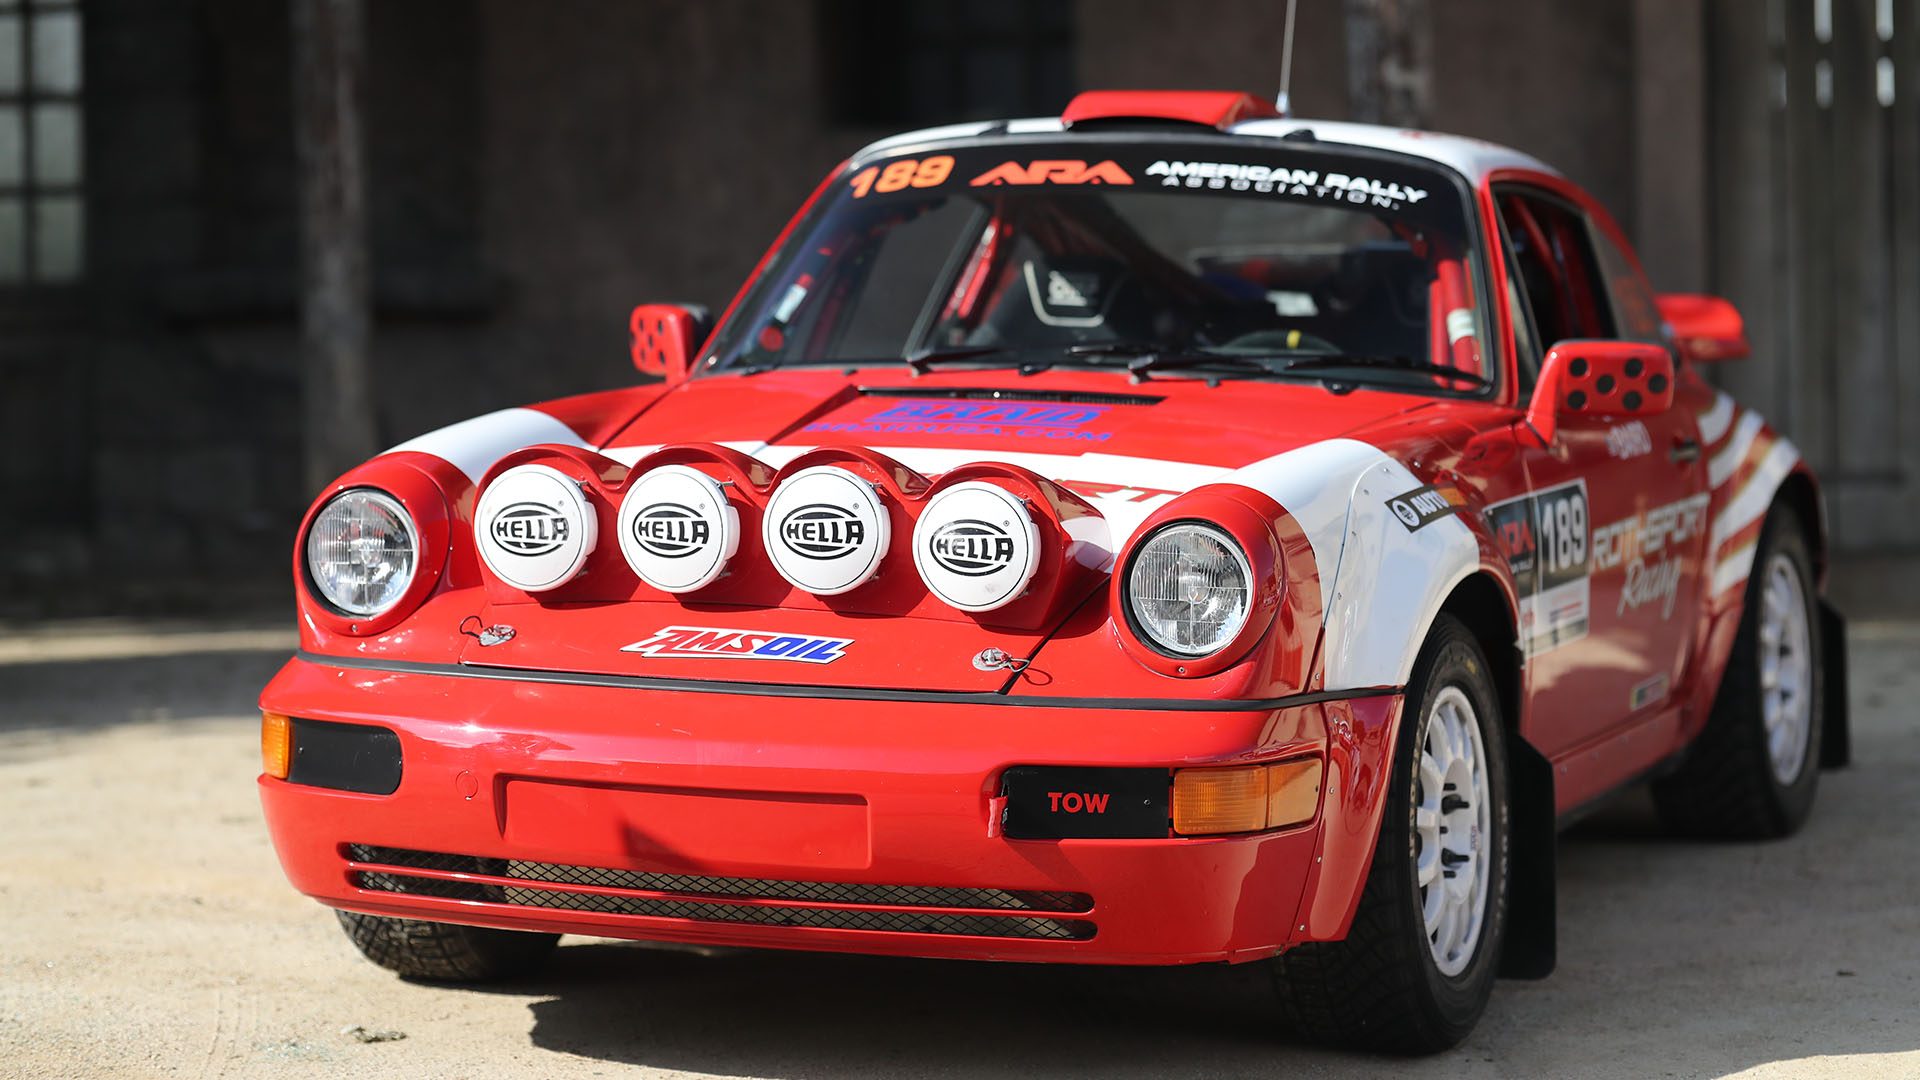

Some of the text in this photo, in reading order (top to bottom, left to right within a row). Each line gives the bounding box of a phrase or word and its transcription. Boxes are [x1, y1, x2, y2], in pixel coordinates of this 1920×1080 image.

[849, 156, 955, 198] 189
[969, 160, 1134, 185] ARA
[1145, 160, 1428, 203] AMERICAN RALLY
[873, 401, 1101, 425] BRAID
[803, 422, 1113, 442] BRAIDUSA.COM
[1410, 490, 1450, 517] AUTO
[497, 517, 569, 542] HELLA
[637, 520, 710, 545] HELLA
[786, 520, 864, 545] HELLA
[1543, 495, 1587, 573] 189
[936, 537, 1014, 562] HELLA
[635, 629, 842, 661] AMSOIL
[1048, 792, 1110, 813] TOW
